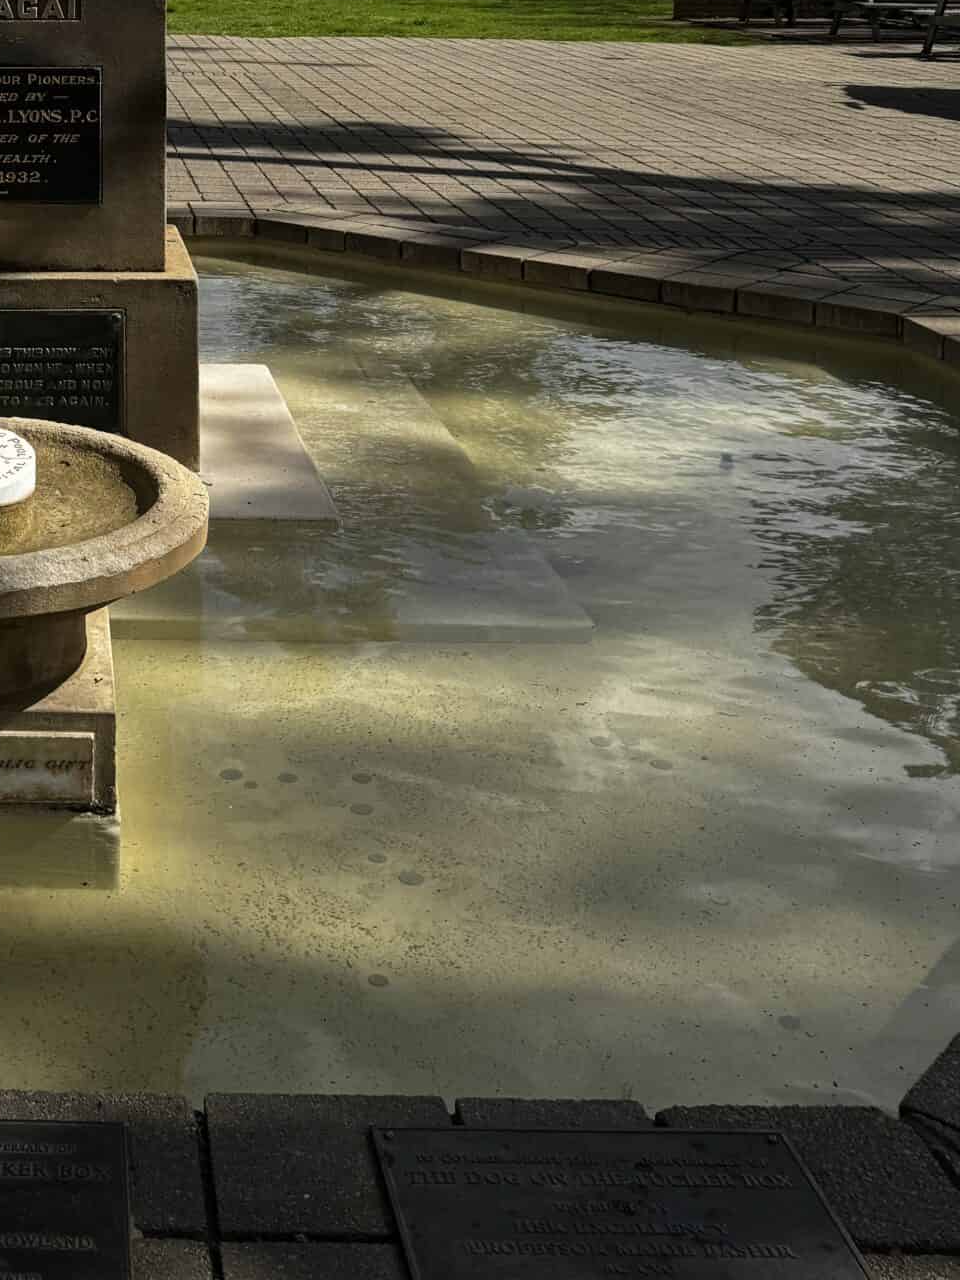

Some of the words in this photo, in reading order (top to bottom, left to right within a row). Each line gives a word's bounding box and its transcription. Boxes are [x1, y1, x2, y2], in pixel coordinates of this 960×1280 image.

[24, 92, 46, 102] BY
[28, 133, 48, 144] OF
[51, 133, 81, 144] THE
[44, 759, 90, 771] GIFT
[55, 1162, 112, 1184] BOX
